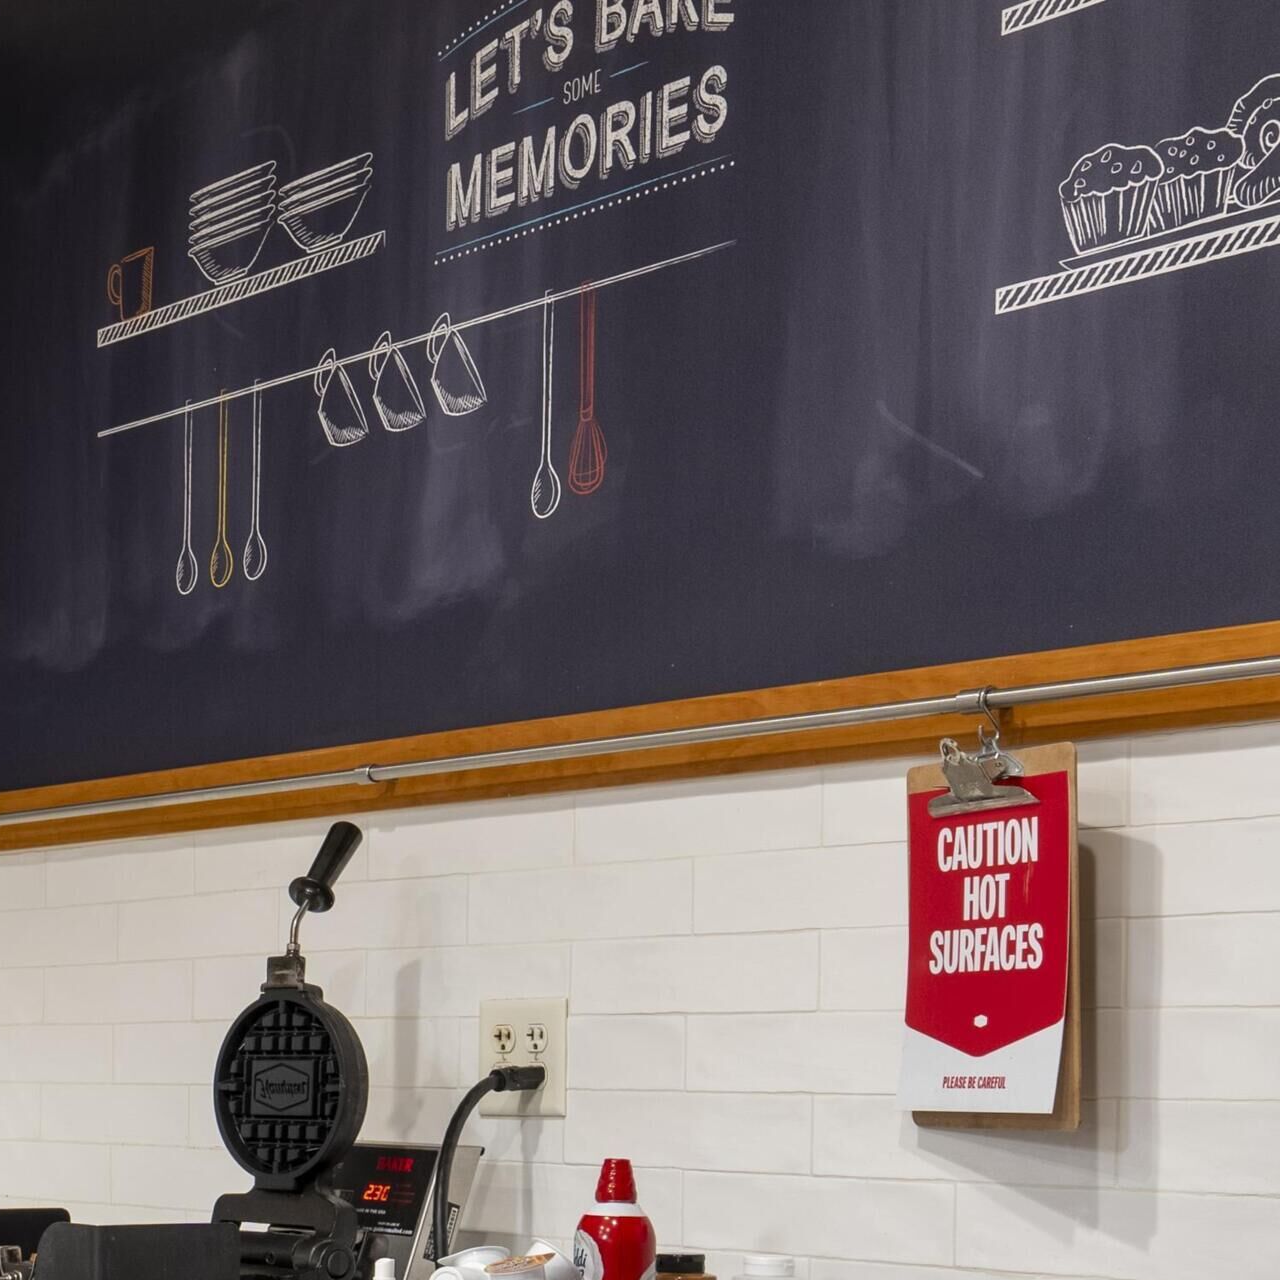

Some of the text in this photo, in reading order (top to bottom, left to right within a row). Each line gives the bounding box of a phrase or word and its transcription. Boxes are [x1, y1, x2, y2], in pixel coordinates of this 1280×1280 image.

[445, 0, 575, 141] LET'S
[562, 69, 602, 105] SOME
[445, 64, 728, 232] MEMORIES
[937, 816, 1039, 872] CAUTION
[962, 873, 1010, 921] HOT
[929, 922, 1044, 975] SURFACES
[942, 1076, 1006, 1089] PLEASE BE CAREFUL
